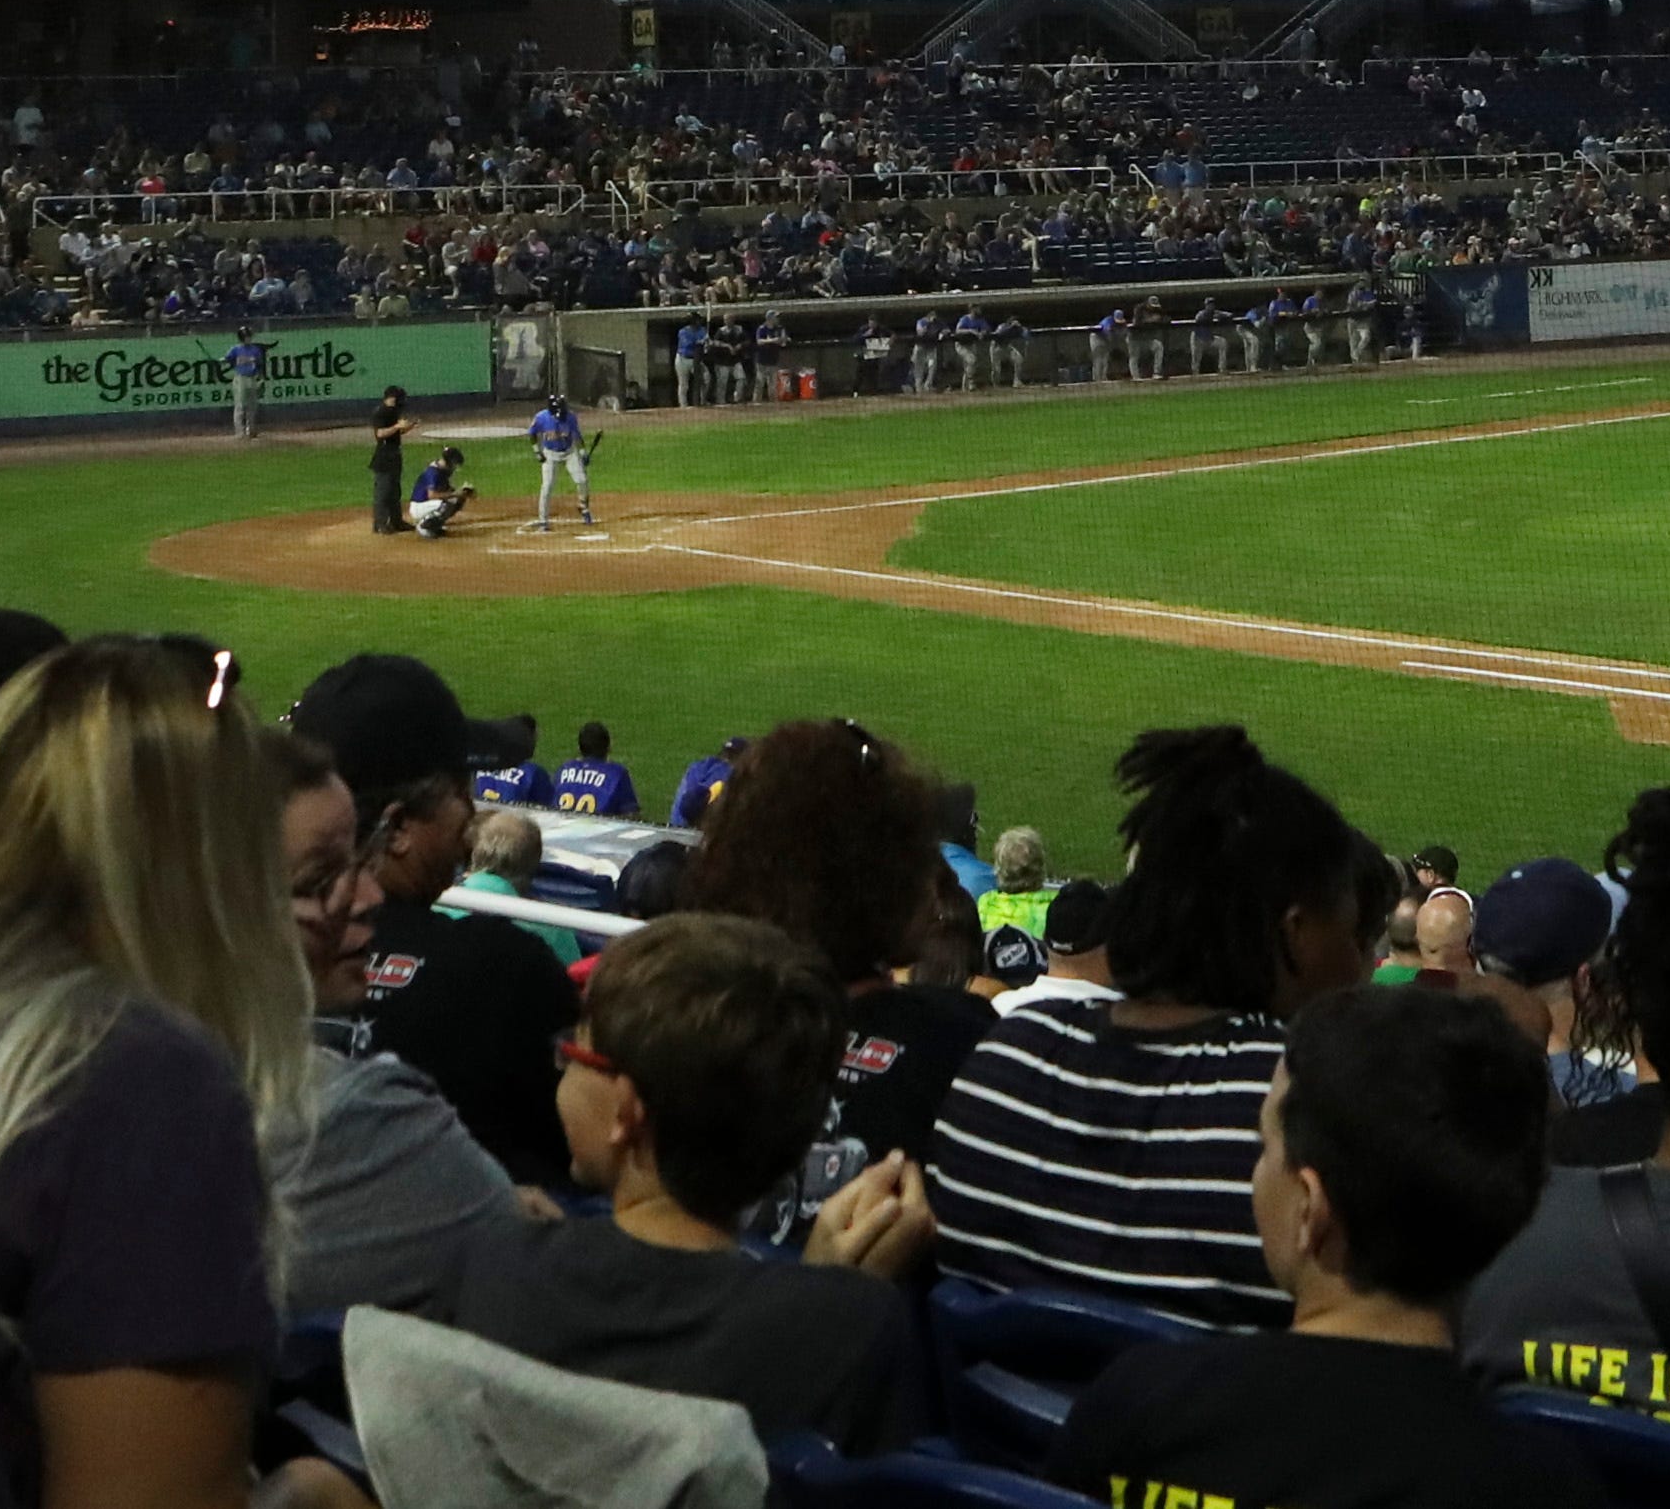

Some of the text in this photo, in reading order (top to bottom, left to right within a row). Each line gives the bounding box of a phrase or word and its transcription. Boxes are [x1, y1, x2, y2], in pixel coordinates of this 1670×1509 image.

[42, 355, 90, 384] the
[95, 350, 234, 402] Greene
[132, 384, 332, 406] SPORTS BA GRILLE
[560, 767, 606, 788] PRATTO
[1523, 1340, 1629, 1398] LIFE
